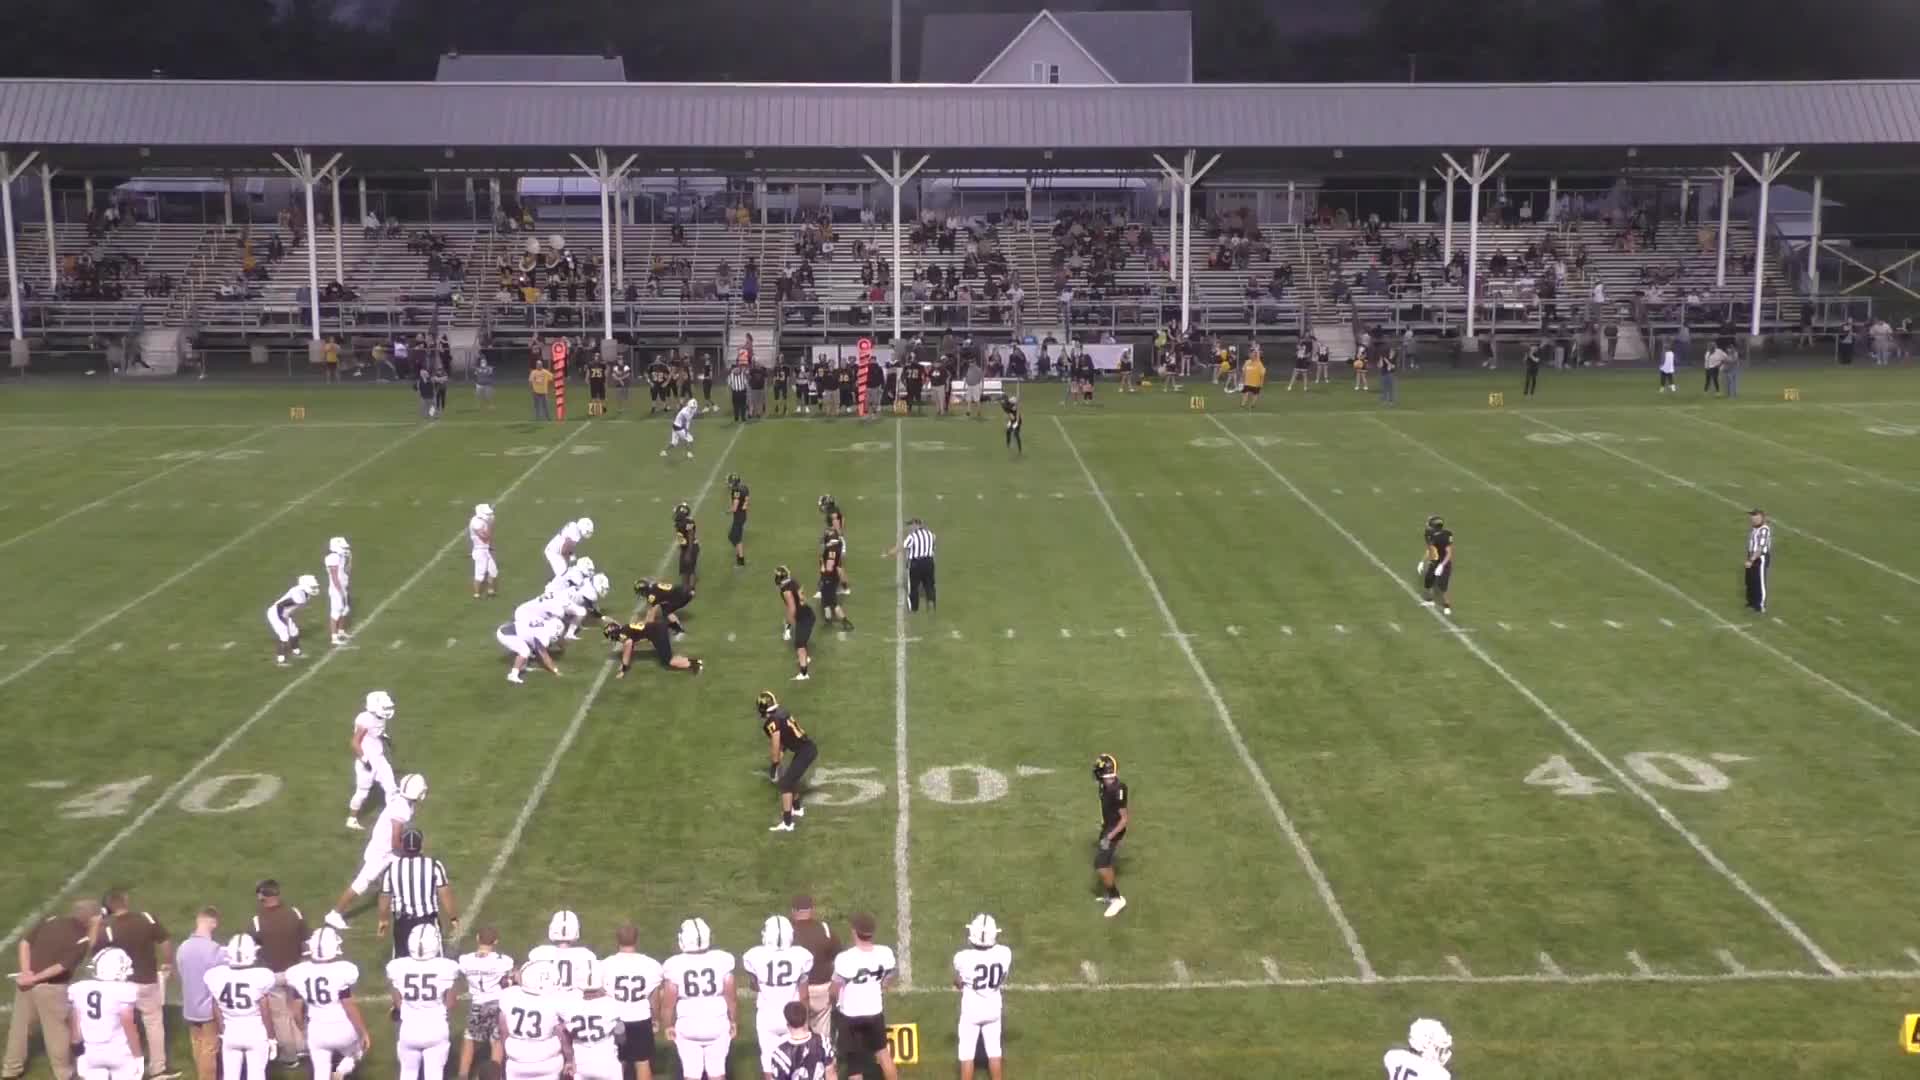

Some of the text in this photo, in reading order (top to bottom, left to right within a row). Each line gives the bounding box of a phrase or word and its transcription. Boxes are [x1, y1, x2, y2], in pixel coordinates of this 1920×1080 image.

[403, 973, 438, 1001] 55
[683, 967, 717, 997] 63
[766, 960, 793, 987] 12
[973, 963, 1004, 990] 20
[219, 982, 252, 1009] 45
[304, 976, 332, 1005] 16
[614, 975, 647, 1002] 52
[87, 990, 102, 1020] 9
[511, 1007, 542, 1038] 73
[570, 1015, 605, 1042] 25
